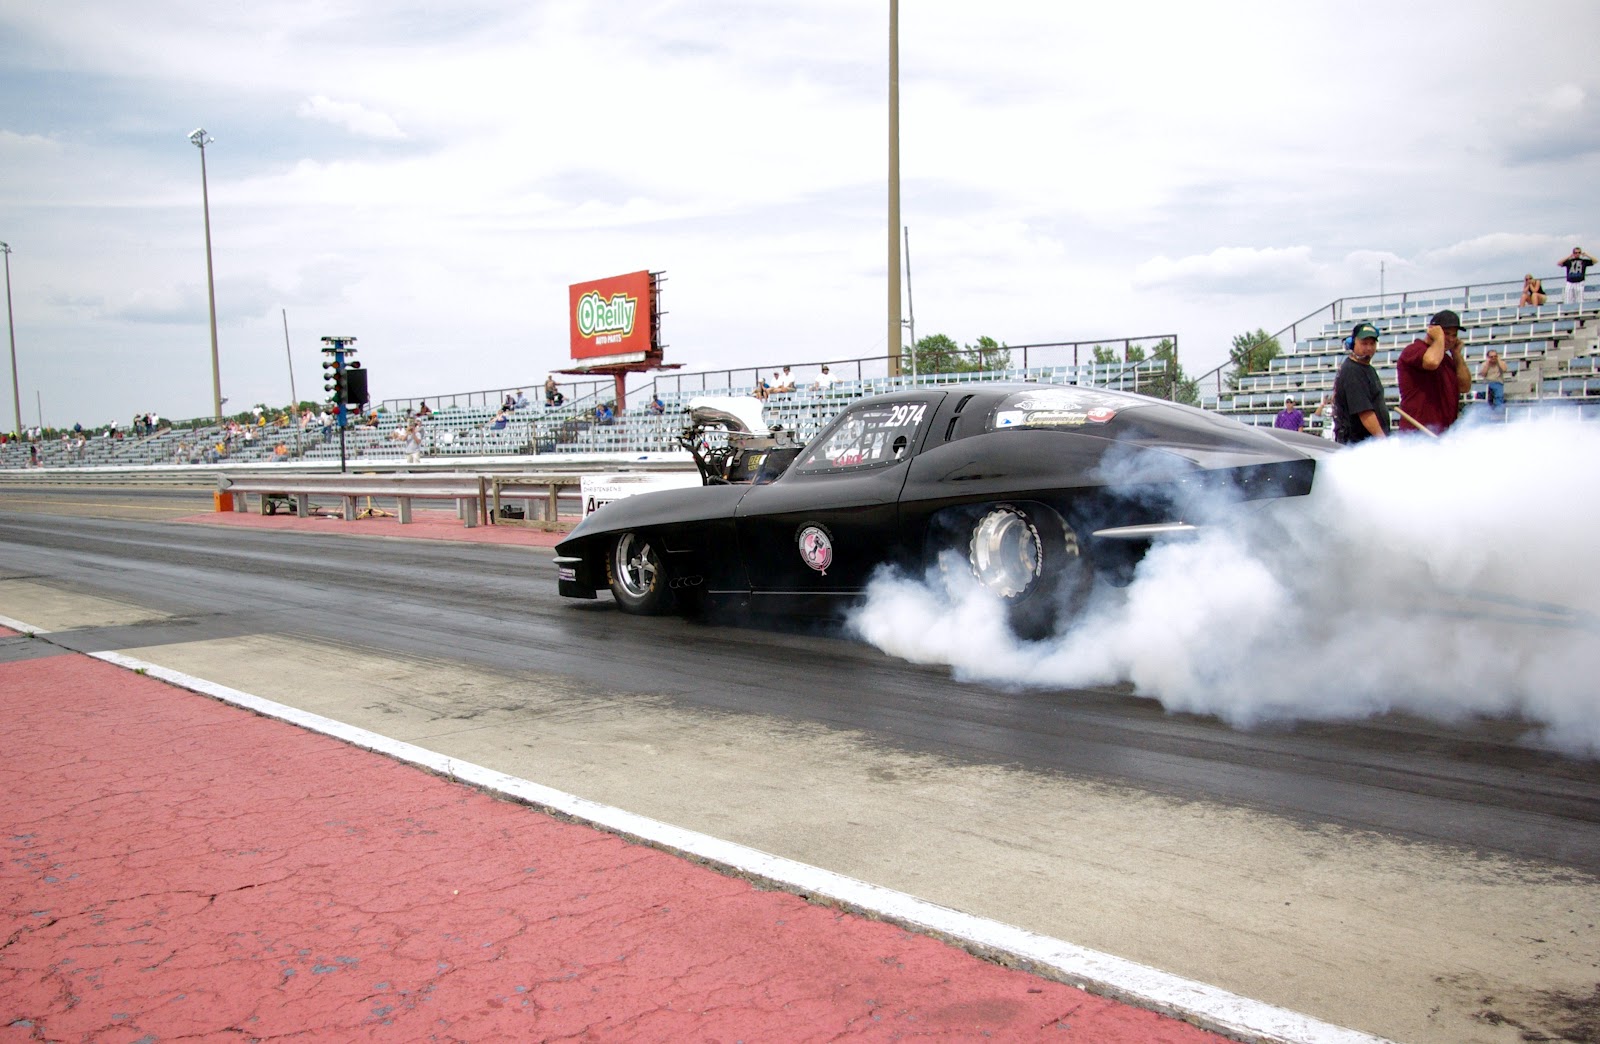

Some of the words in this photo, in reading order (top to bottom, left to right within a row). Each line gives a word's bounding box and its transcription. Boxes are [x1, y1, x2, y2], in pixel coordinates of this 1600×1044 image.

[579, 296, 633, 331] O'Reilly
[595, 335, 607, 345] AUTO
[607, 333, 622, 343] PARTS
[884, 404, 927, 427] 2974
[1029, 524, 1042, 578] RACING
